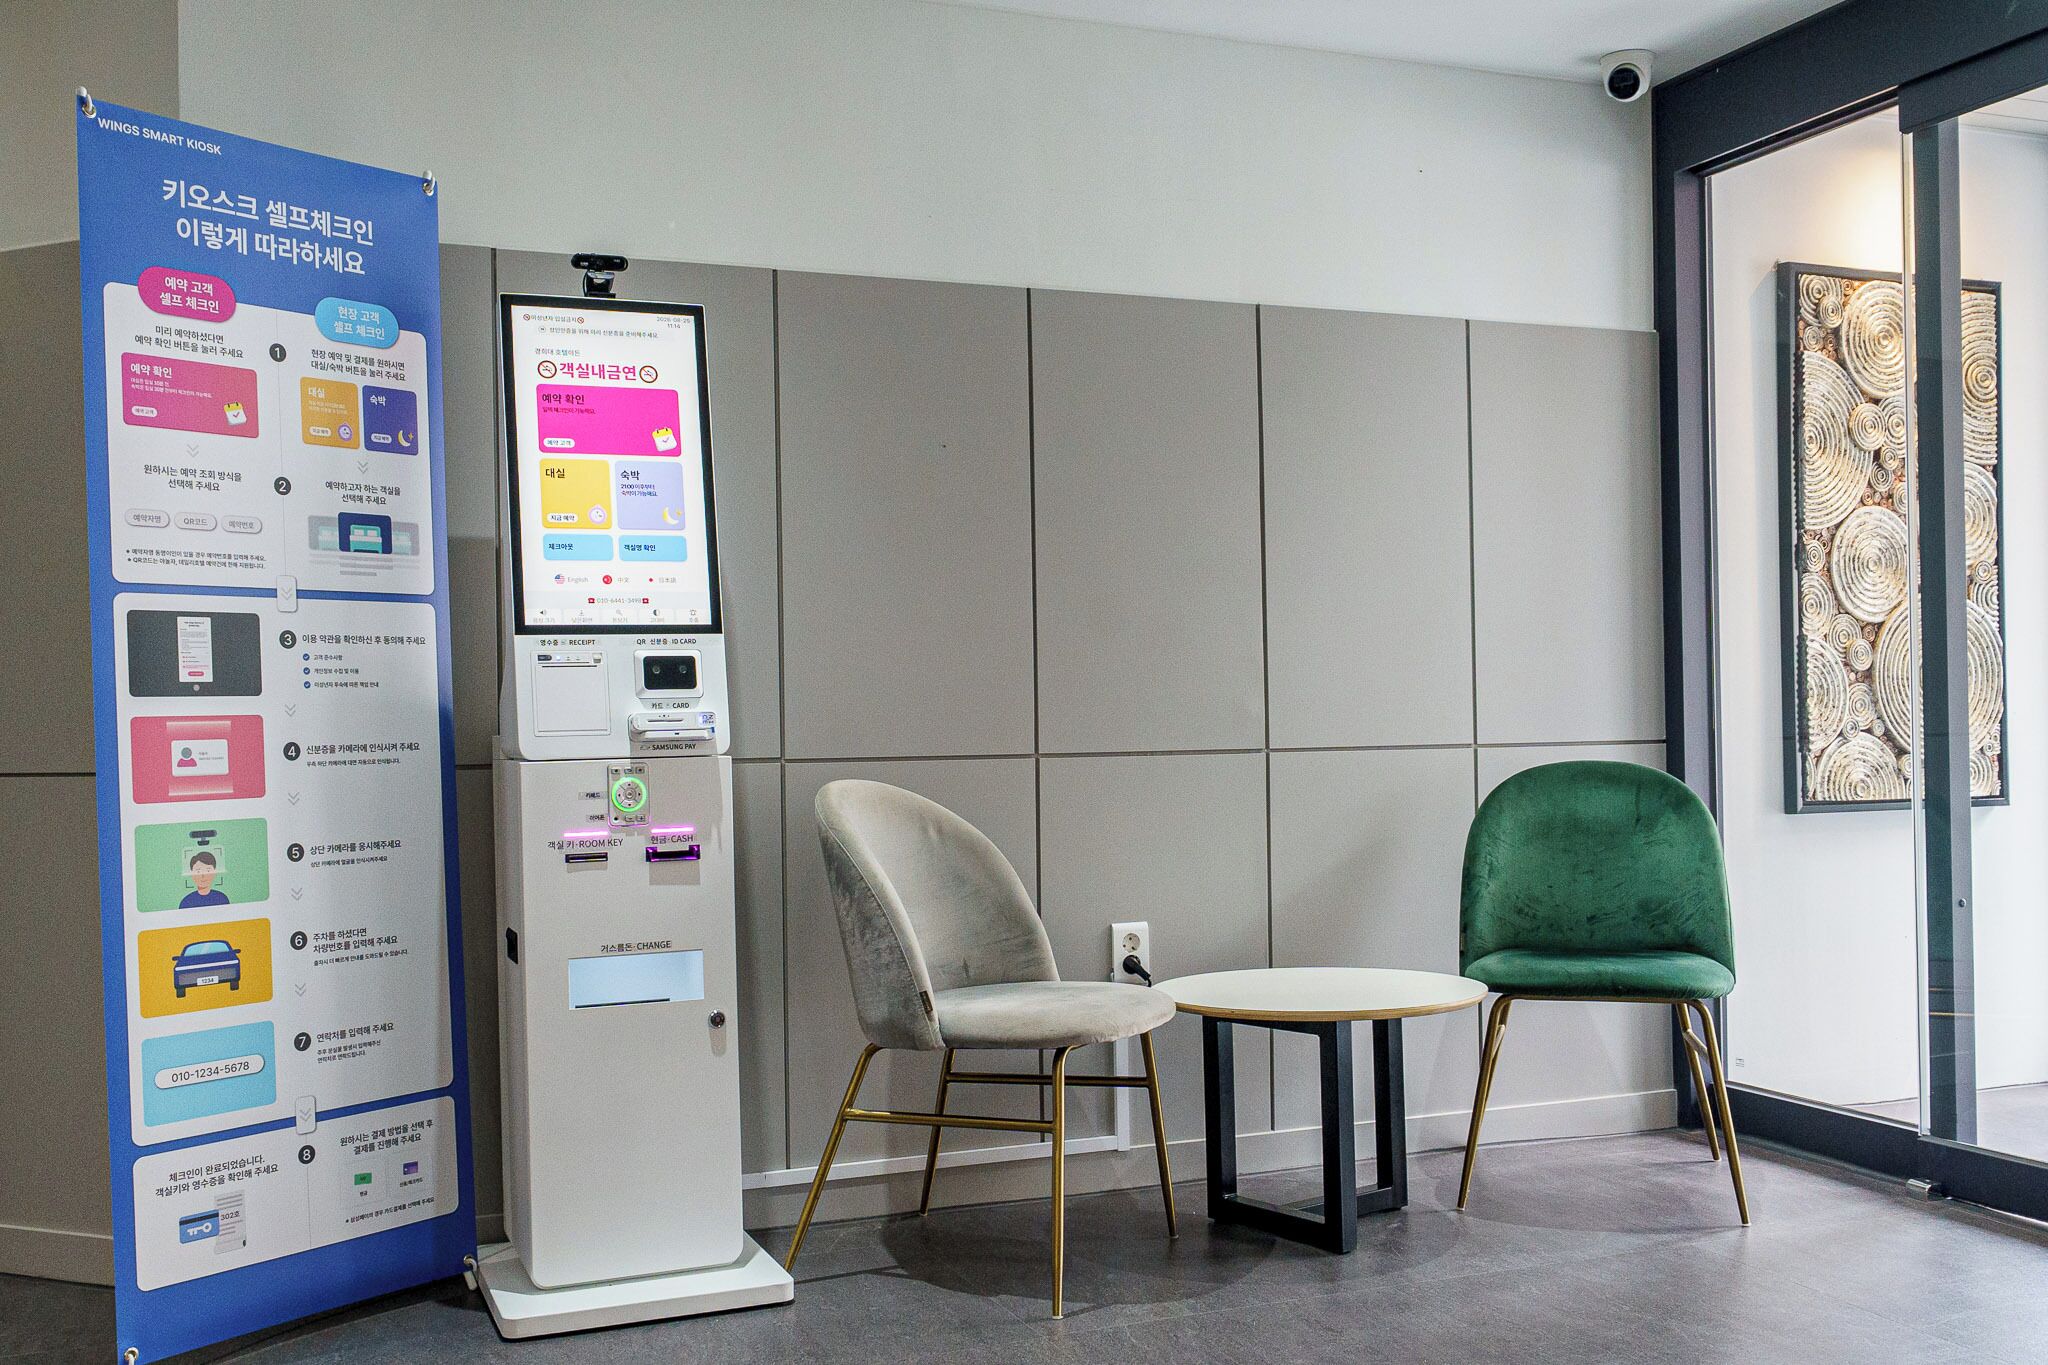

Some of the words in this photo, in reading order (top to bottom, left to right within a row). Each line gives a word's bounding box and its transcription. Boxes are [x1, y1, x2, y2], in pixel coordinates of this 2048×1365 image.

[98, 118, 140, 136] WINGS
[142, 128, 184, 146] SMART
[187, 138, 222, 155] KIOSK
[162, 179, 259, 220] 키오스크
[265, 200, 373, 246] 셀프체크인
[176, 217, 248, 255] 이렇게
[255, 232, 365, 275] 따라하세요
[165, 276, 188, 292] 예약
[191, 281, 213, 296] 고객
[160, 292, 183, 307] 셀프
[186, 297, 220, 314] 체크인
[337, 306, 357, 320] 현장
[360, 309, 380, 323] 고객
[155, 325, 172, 336] 미리
[174, 328, 224, 344] 예약하셨다면
[334, 320, 354, 334] 셀프
[356, 324, 385, 340] 체크인
[134, 334, 152, 346] 예약
[154, 337, 172, 349] 확인
[173, 339, 199, 352] 버튼을
[201, 344, 218, 356] 눌러
[220, 347, 244, 359] 주세요
[311, 349, 326, 359] 현장
[328, 351, 342, 361] 예약
[345, 353, 352, 363] 및
[354, 355, 375, 367] 결제를
[377, 358, 405, 371] 원하시면
[131, 363, 151, 376] 예약
[153, 366, 173, 379] 확인
[311, 360, 343, 373] 대실/숙박
[345, 365, 367, 376] 버튼을
[369, 368, 383, 379] 눌러
[385, 370, 406, 381] 주세요
[559, 362, 637, 380] 객실내금연
[308, 387, 325, 398] 대실
[370, 394, 386, 406] 숙박
[542, 394, 561, 404] 예약
[565, 394, 584, 405] 확인
[143, 464, 178, 476] 원하시는
[180, 467, 197, 478] 예약
[199, 469, 216, 480] 조회
[217, 471, 242, 482] 방식을
[545, 468, 566, 479] 대실
[620, 470, 640, 480] 숙박
[168, 479, 193, 490] 선택해
[195, 481, 220, 491] 주세요
[325, 481, 362, 493] 예약하고자
[364, 485, 378, 494] 하는
[380, 486, 401, 496] 객실을
[342, 495, 364, 504] 선택해
[365, 496, 387, 505] 주세요
[133, 513, 161, 524] 예약자명
[183, 518, 208, 526] QR코드
[228, 520, 254, 530] 예약번호
[548, 543, 574, 551] 체크아웃
[302, 634, 317, 644] 이용
[319, 634, 341, 644] 약관을
[343, 635, 372, 645] 확인하신
[374, 636, 381, 645] 후
[383, 636, 404, 645] 동의해
[406, 636, 426, 645] 주세요
[650, 638, 668, 646] 신분증
[306, 745, 336, 754] 신분증을
[338, 744, 368, 753] 카메라에
[369, 743, 398, 752] 인식시켜
[399, 742, 420, 751] 주세요
[310, 845, 325, 855] 상단
[327, 843, 357, 853] 카메라를
[359, 839, 401, 851] 응시해주세요
[547, 840, 564, 850] 객실
[608, 838, 623, 847] KEY
[313, 931, 336, 942] 주차를
[337, 928, 367, 939] 하셨다면
[313, 941, 351, 953] 차량번호를
[353, 938, 375, 949] 입력해
[377, 935, 398, 946] 주세요
[317, 1030, 346, 1042] 연락처를
[348, 1026, 370, 1037] 입력해
[373, 1023, 394, 1033] 주세요
[171, 1061, 250, 1083] 010-1234-5678
[340, 1133, 370, 1147] 원하시는
[371, 1129, 386, 1140] 결제
[387, 1124, 409, 1137] 방법을
[410, 1121, 425, 1132] 선택
[426, 1119, 434, 1128] 후
[353, 1142, 375, 1155] 결제를
[377, 1138, 399, 1150] 진행해
[401, 1132, 422, 1144] 주세요
[168, 1168, 203, 1183] 체크인이
[205, 1154, 265, 1175] 완료되었습니다.
[155, 1183, 190, 1198] 객실키와
[192, 1175, 225, 1191] 영수증을
[228, 1169, 252, 1182] 확인해
[254, 1163, 279, 1177] 주세요
[220, 1210, 240, 1221] 302호
